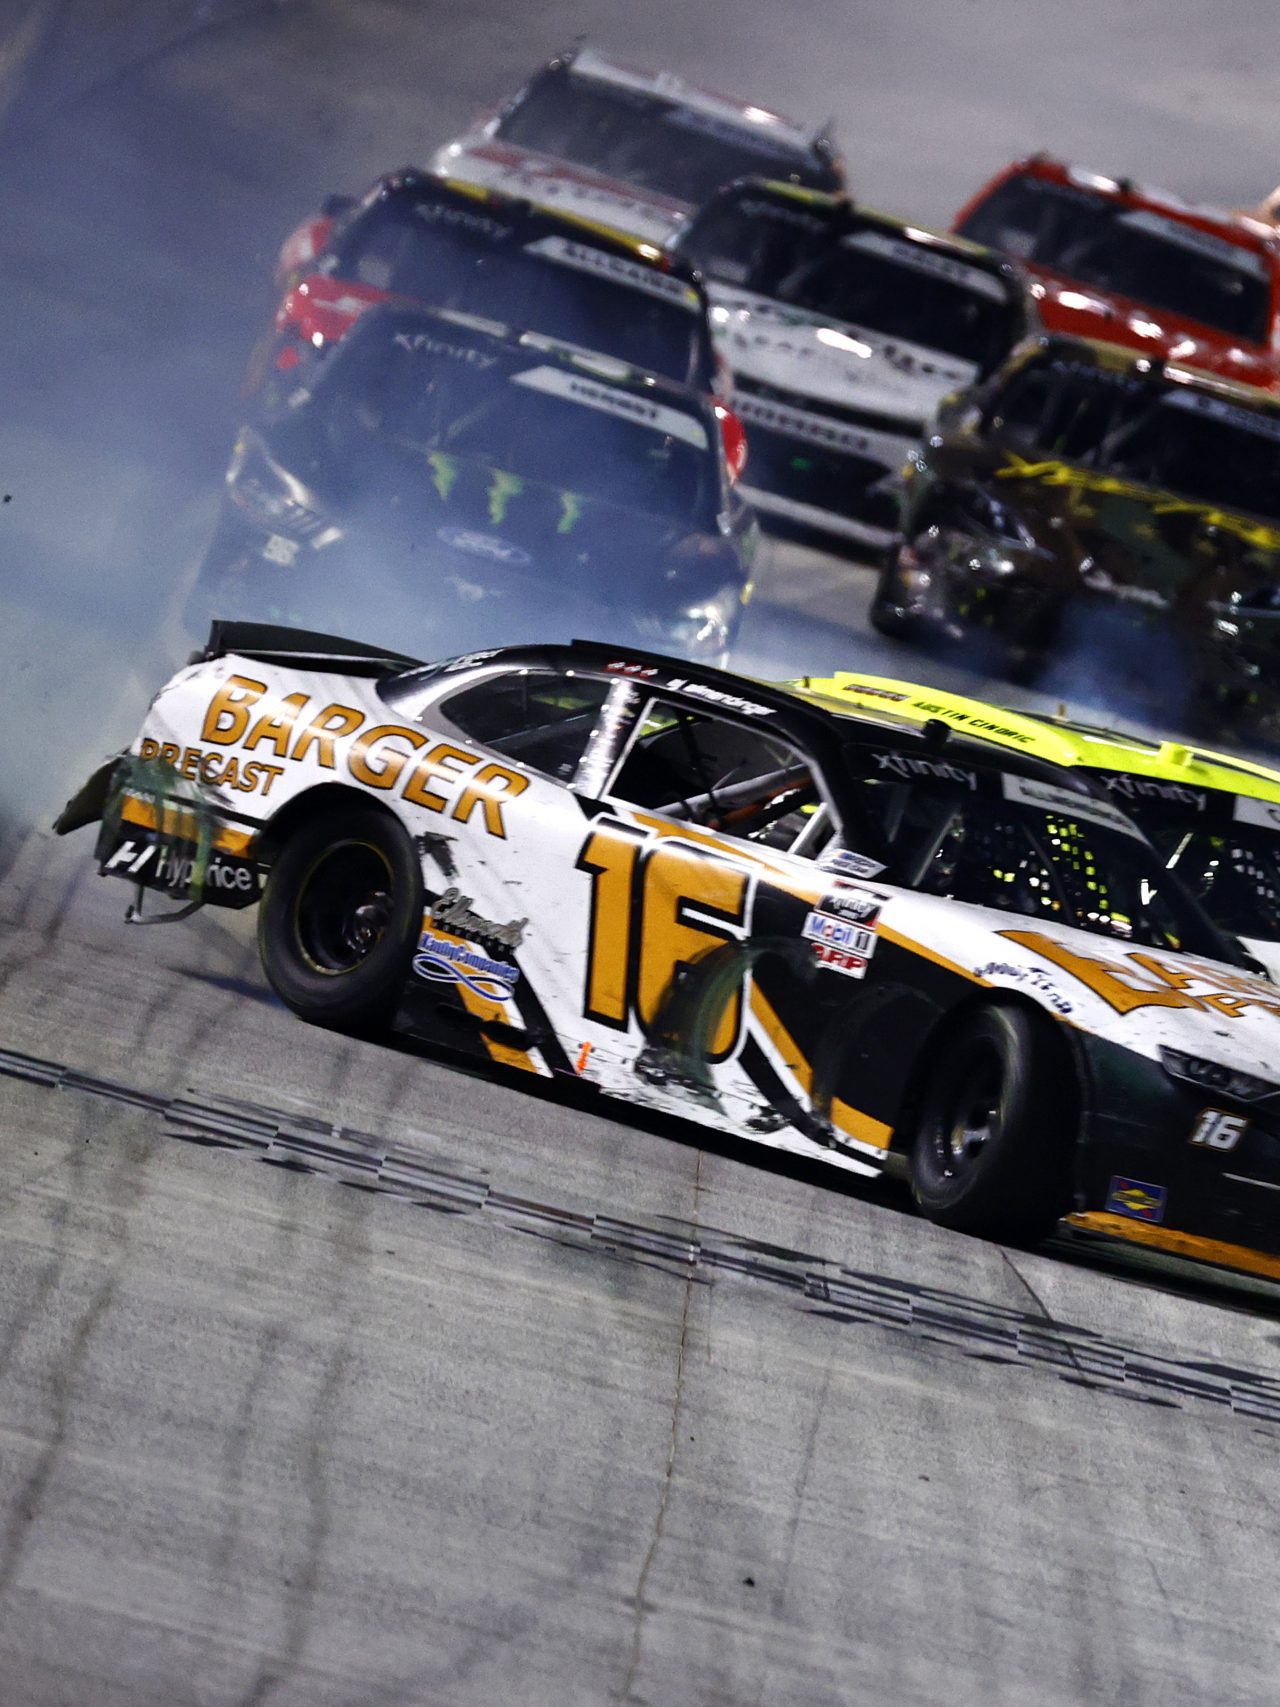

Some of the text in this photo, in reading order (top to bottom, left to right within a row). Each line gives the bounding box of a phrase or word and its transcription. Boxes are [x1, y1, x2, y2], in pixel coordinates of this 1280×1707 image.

[138, 736, 286, 797] PRECAST
[200, 673, 532, 841] BARGER
[871, 752, 978, 792] xfinity
[1100, 773, 1207, 812] xfinity
[154, 845, 252, 892] Hyprice
[574, 815, 757, 1064] 16
[811, 915, 853, 945] Mobil
[1190, 1107, 1249, 1152] 16
